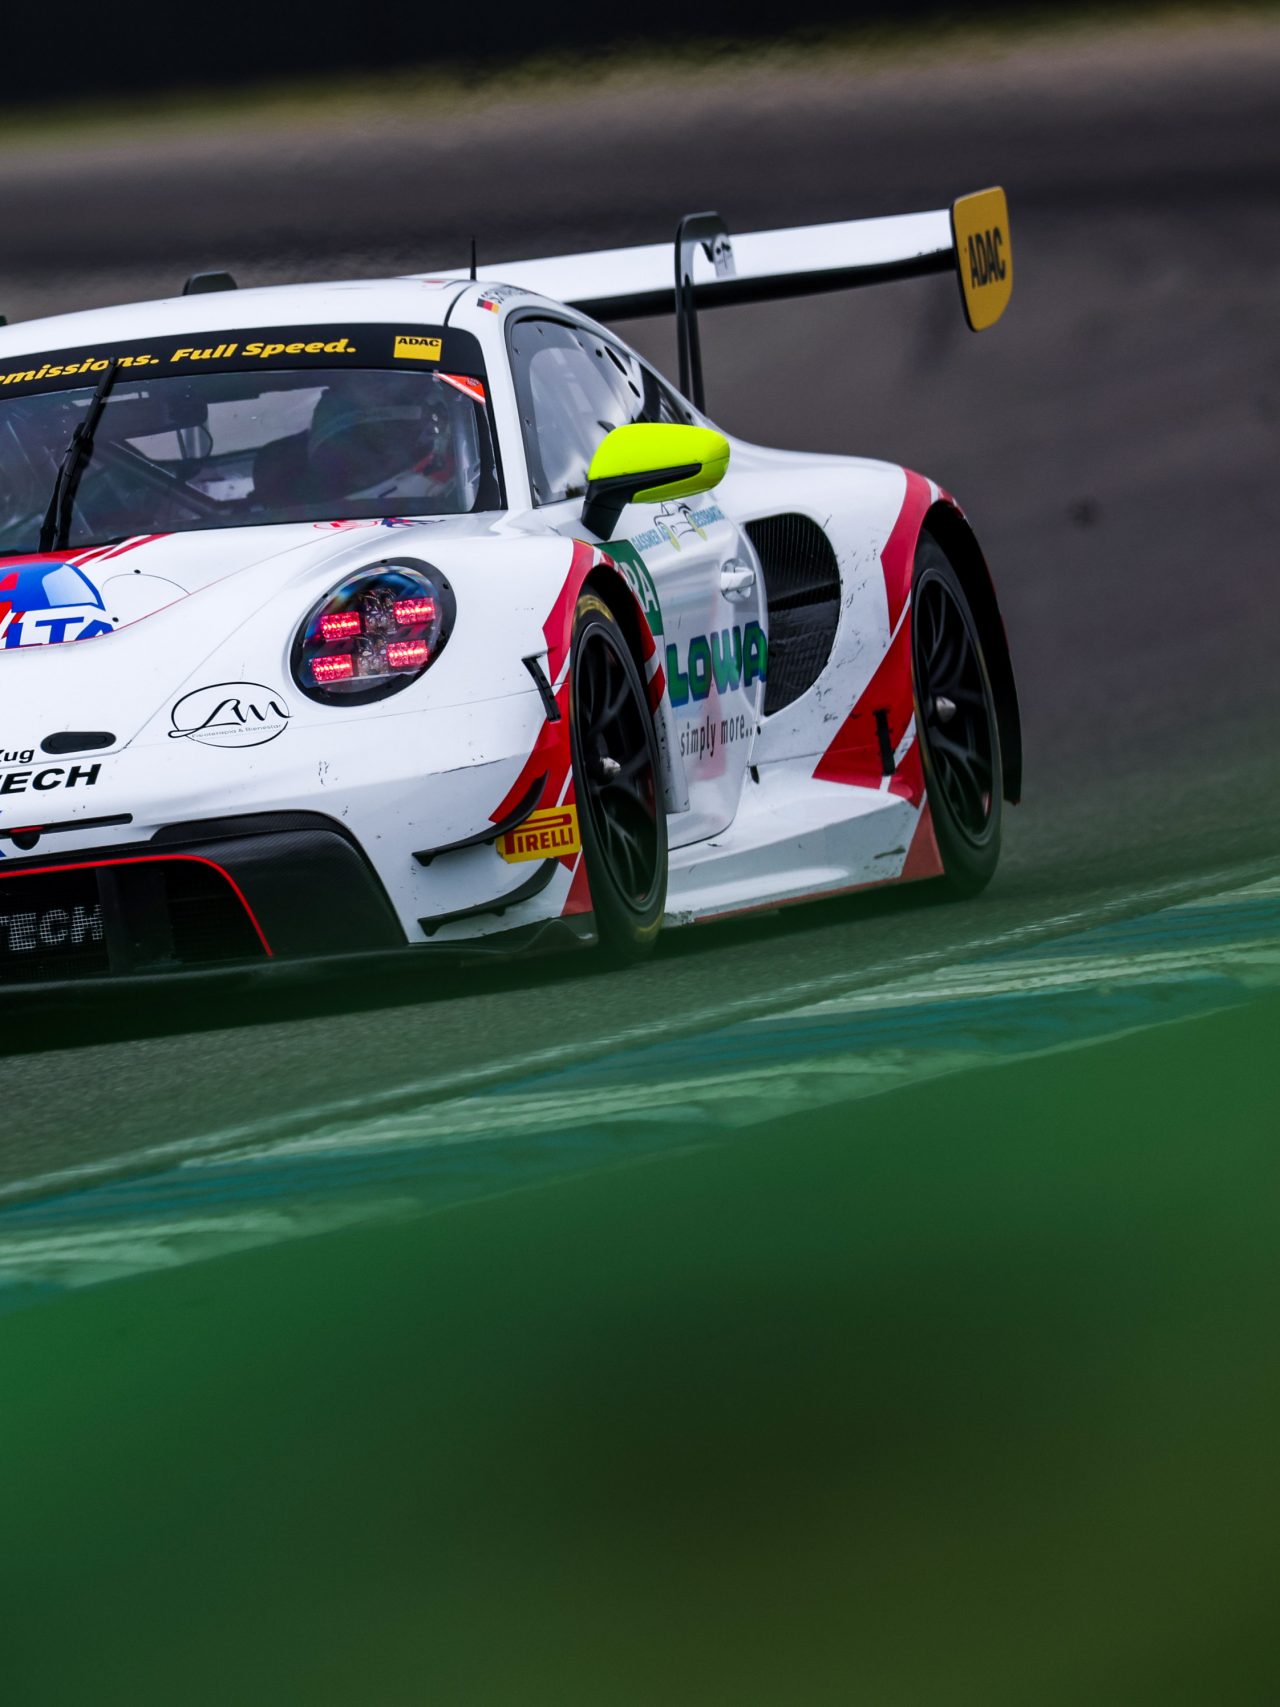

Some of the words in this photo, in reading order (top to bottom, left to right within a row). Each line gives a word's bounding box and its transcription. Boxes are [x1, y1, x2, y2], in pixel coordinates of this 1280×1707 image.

[967, 226, 1006, 290] ADAC
[170, 343, 239, 363] Full
[241, 338, 357, 358] Speed.
[397, 337, 440, 348] ADAC
[665, 620, 768, 709] LOWA
[680, 715, 716, 761] simply
[504, 813, 574, 855] PIRELLI
